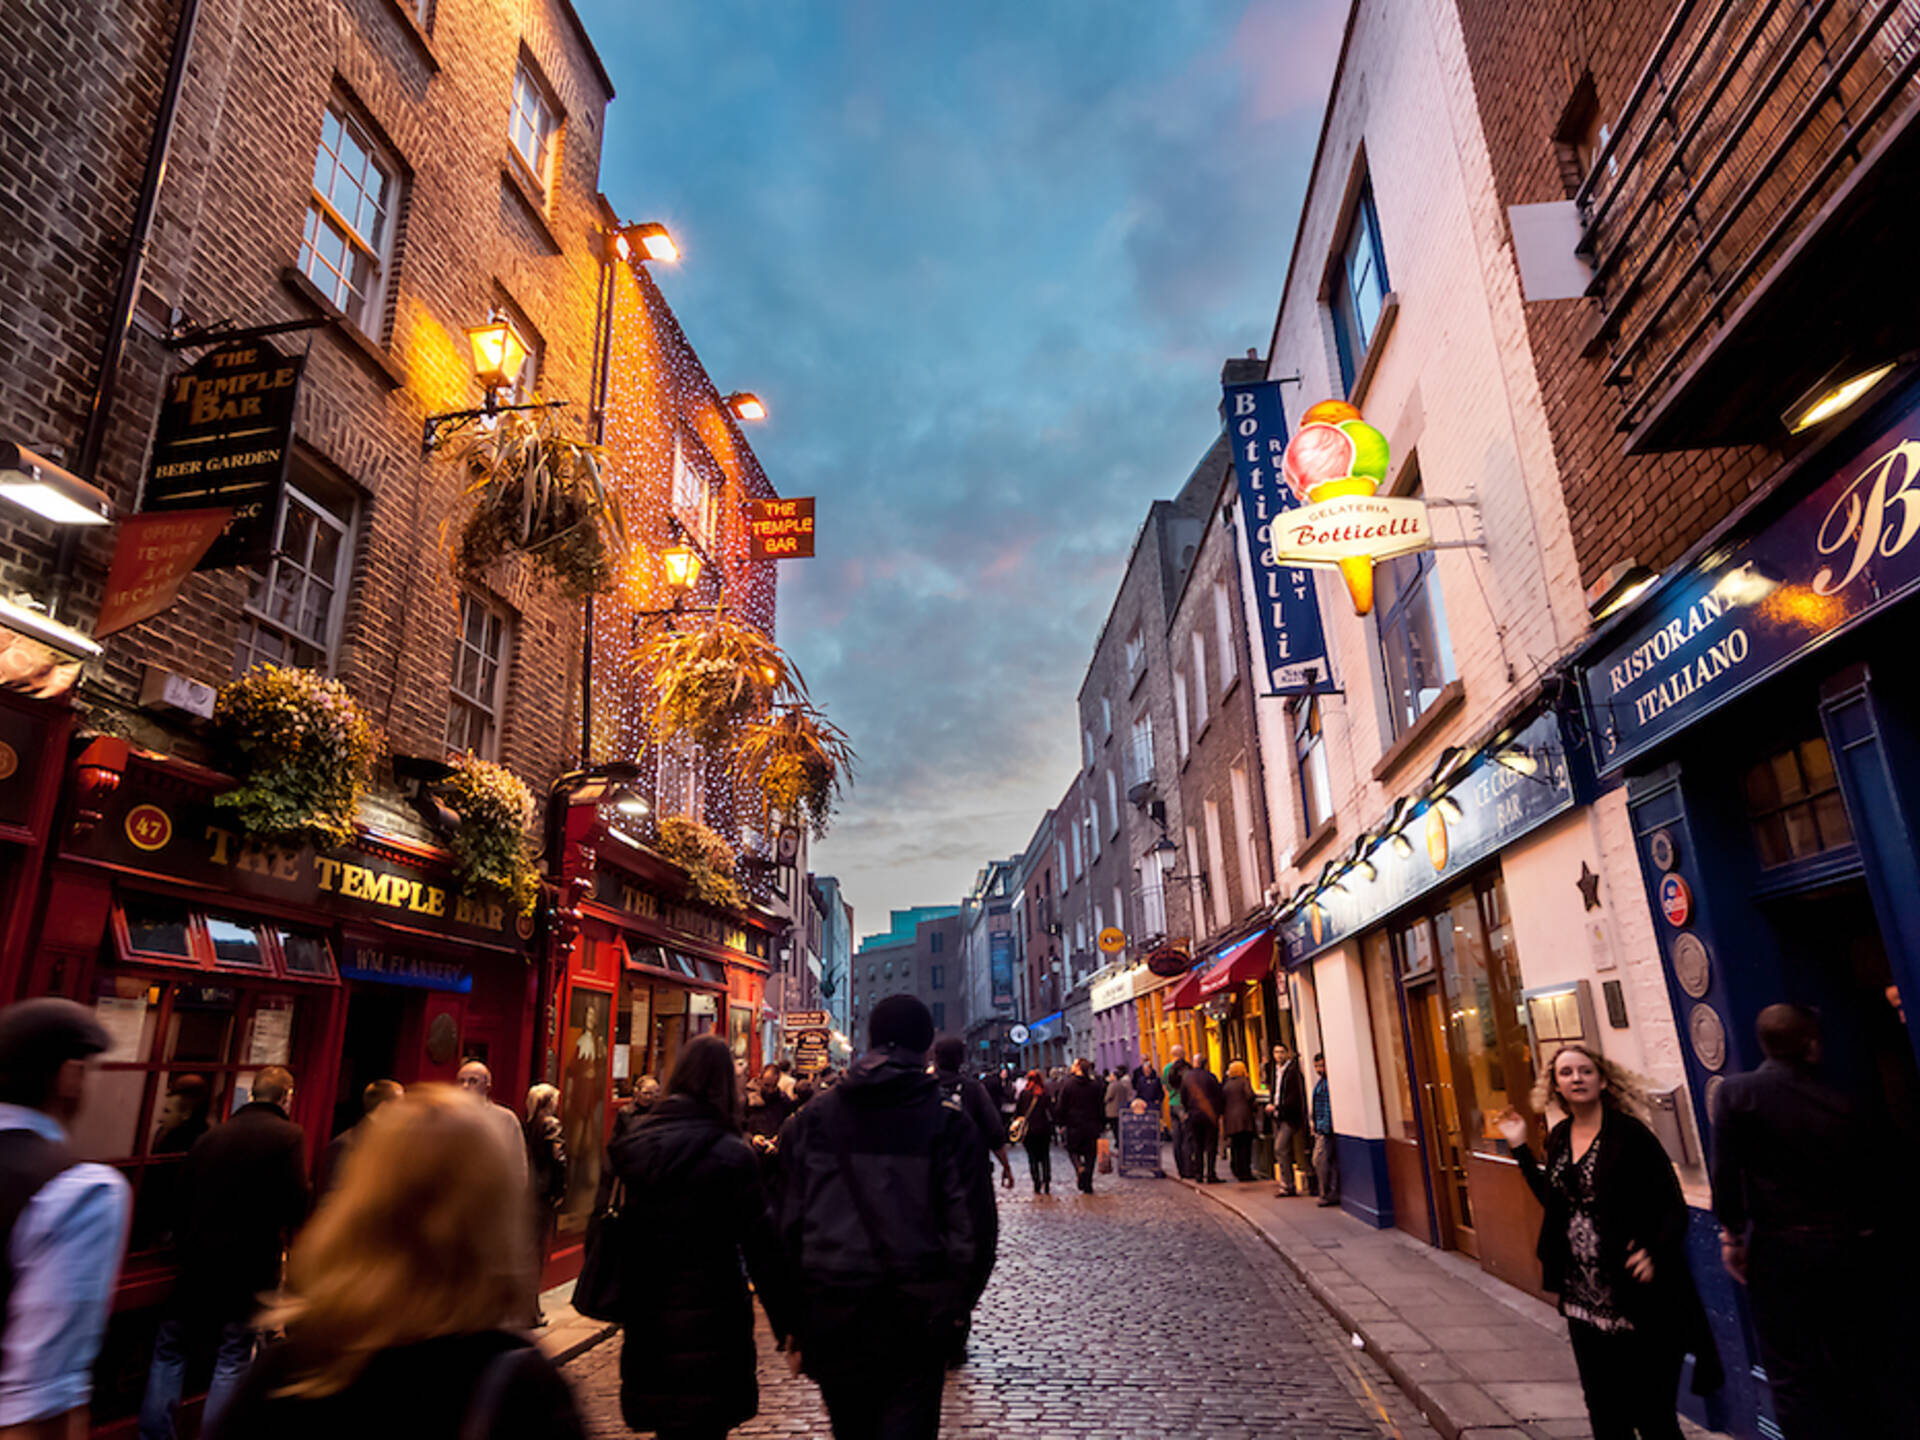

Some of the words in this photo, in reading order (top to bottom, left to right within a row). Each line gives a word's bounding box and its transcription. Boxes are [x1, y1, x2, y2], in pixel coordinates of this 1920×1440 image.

[213, 349, 258, 368] THE
[174, 368, 296, 403] TEMPLE
[189, 396, 263, 425] BAR
[155, 460, 203, 479] BEER
[205, 449, 281, 471] GARDEN
[766, 502, 797, 516] THE
[1308, 503, 1390, 522] GELATERIA
[752, 517, 813, 536] TEMPLE
[1288, 517, 1420, 547] Botticelli
[764, 537, 798, 553] BAR
[1609, 588, 1738, 695] RISTORAN
[1634, 628, 1749, 727] ITALIANO
[135, 816, 162, 839] 47
[313, 854, 446, 917] TEMPLE
[455, 893, 504, 932] BAR
